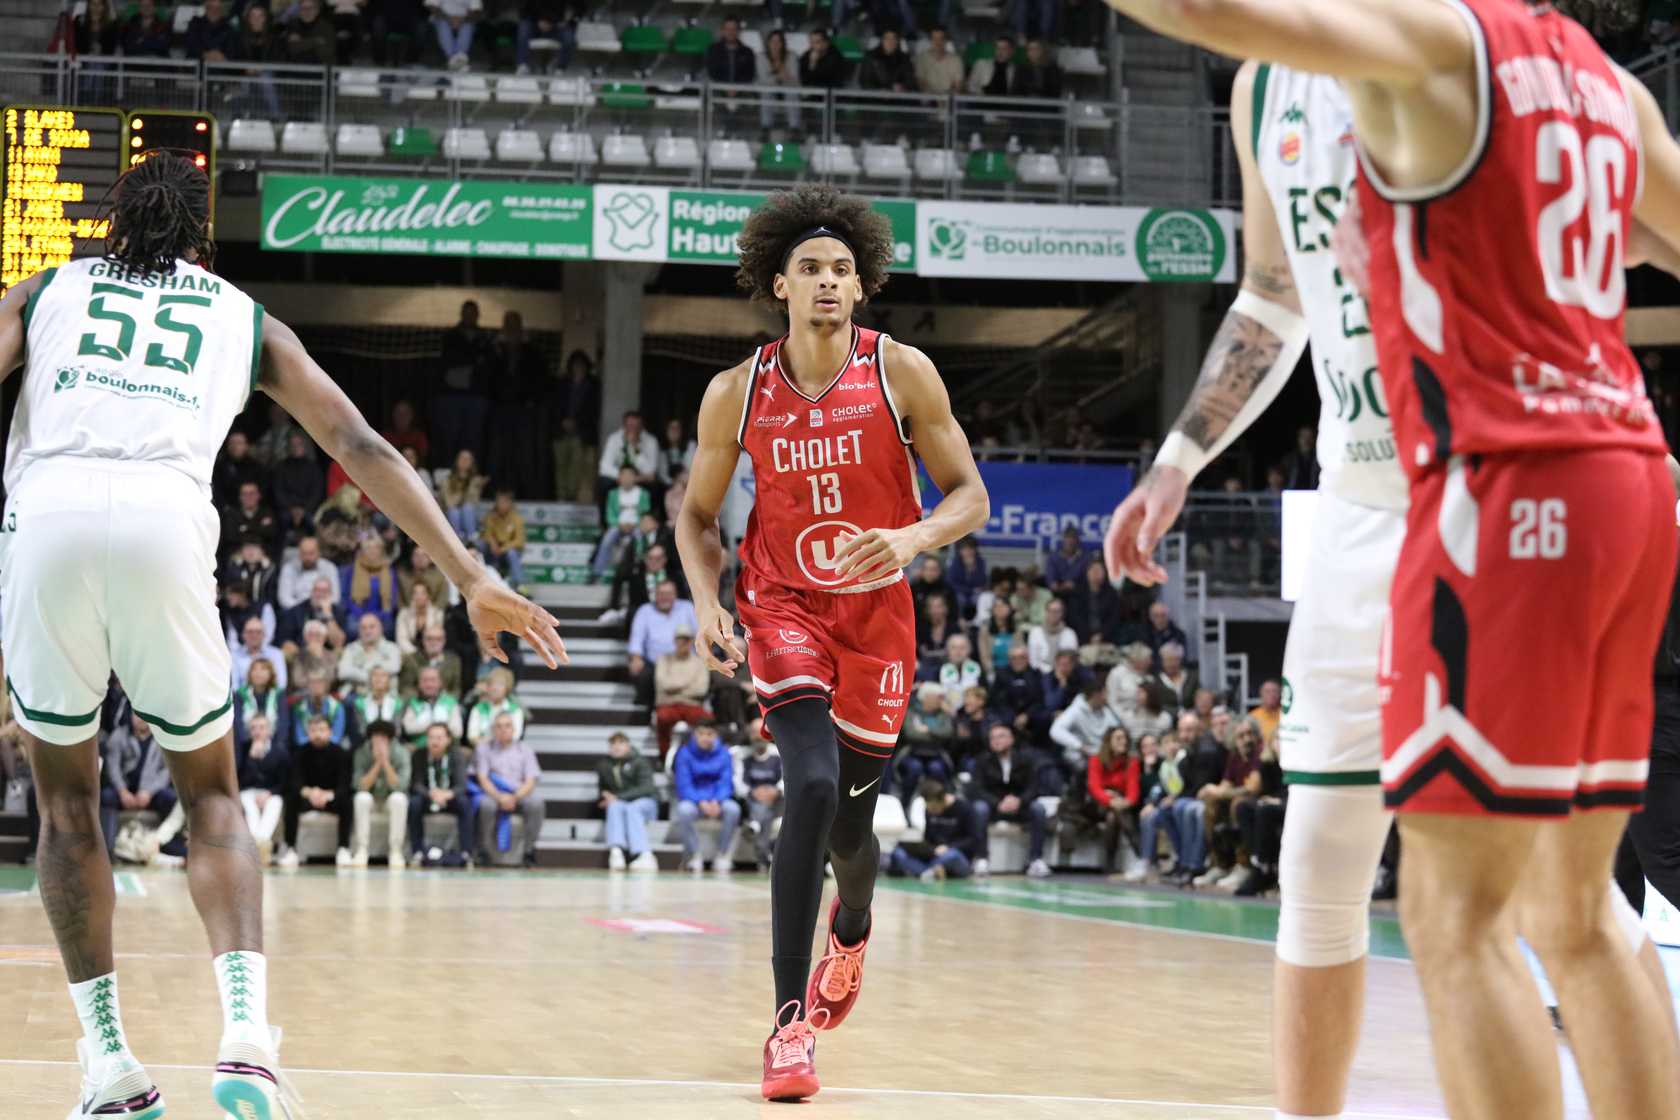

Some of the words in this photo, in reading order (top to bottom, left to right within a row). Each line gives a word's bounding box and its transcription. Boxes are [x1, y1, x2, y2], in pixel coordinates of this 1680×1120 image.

[265, 182, 494, 249] Claudelec
[672, 199, 750, 225] Région
[1537, 121, 1627, 319] 26
[984, 234, 1126, 258] Boulonnais
[88, 262, 221, 295] GRESHAM
[78, 283, 212, 374] 55
[772, 429, 863, 473] CHOLET
[807, 472, 842, 515] 13
[1509, 498, 1568, 560] 26
[878, 699, 904, 708] CHOLET
